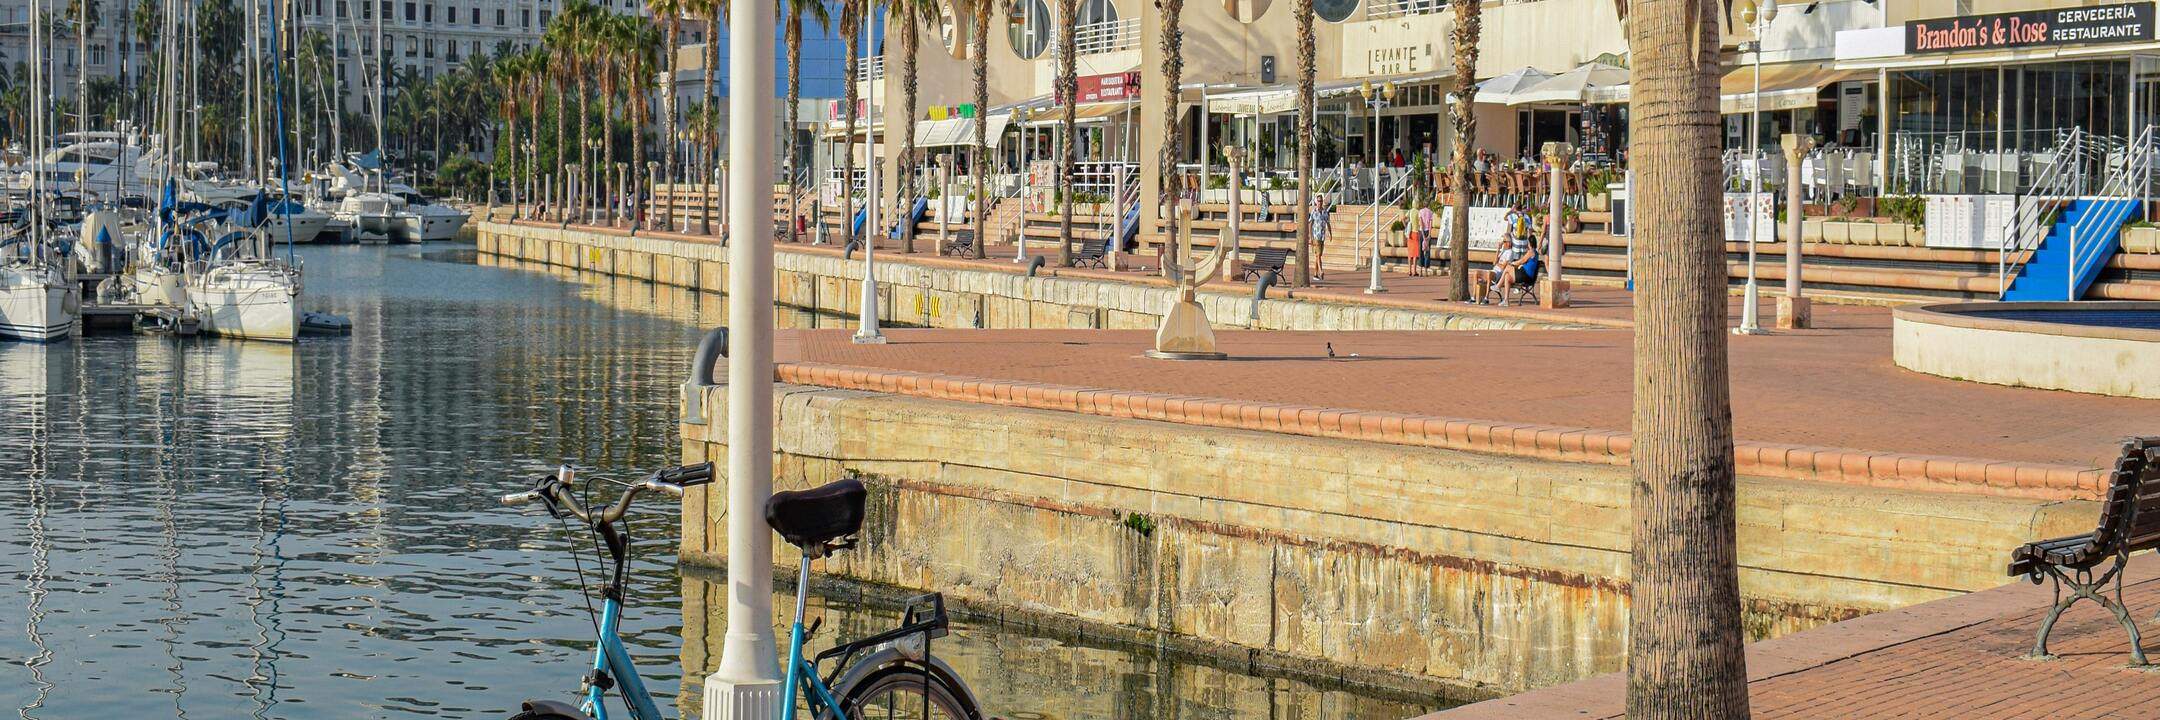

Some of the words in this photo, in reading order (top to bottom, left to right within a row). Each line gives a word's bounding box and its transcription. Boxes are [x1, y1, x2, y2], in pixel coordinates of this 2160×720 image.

[2058, 5, 2136, 23] CERVECERÍA
[1916, 19, 1987, 50] Brandon's
[1992, 17, 2006, 45] &
[2009, 16, 2047, 44] Rose
[2052, 23, 2142, 41] RESTAURANTE
[1368, 46, 1417, 74] LEVANTE
[1381, 63, 1401, 74] BAR
